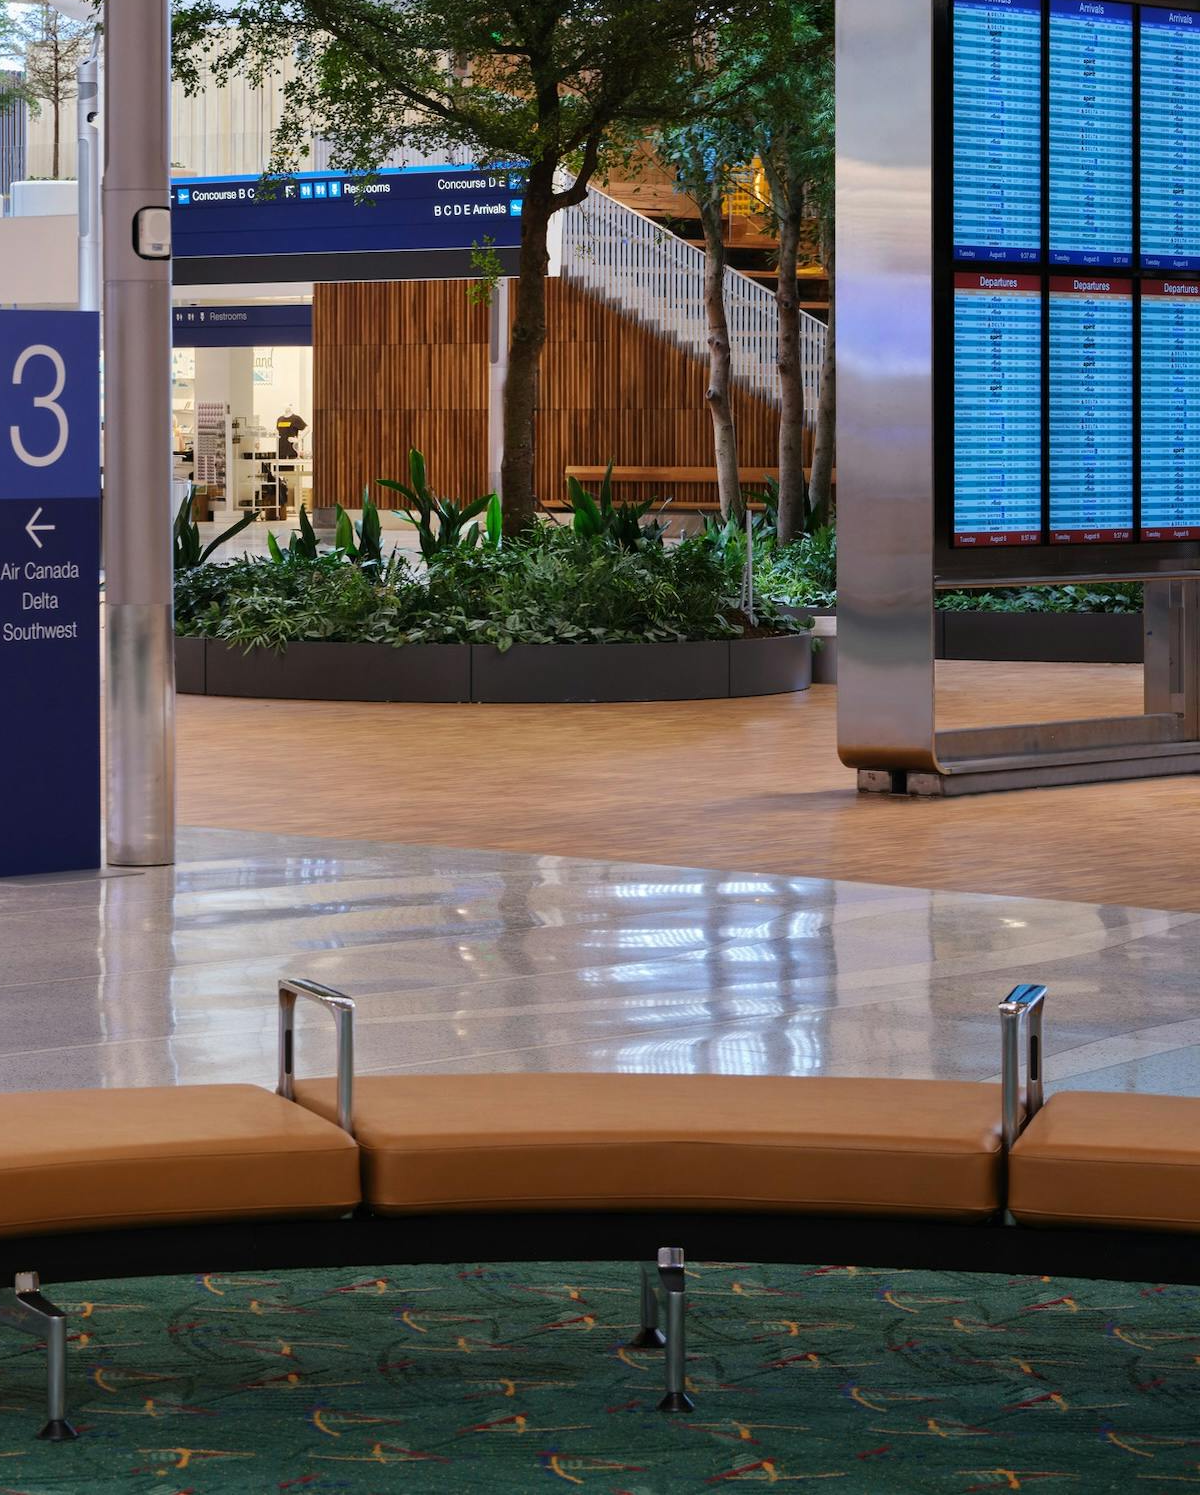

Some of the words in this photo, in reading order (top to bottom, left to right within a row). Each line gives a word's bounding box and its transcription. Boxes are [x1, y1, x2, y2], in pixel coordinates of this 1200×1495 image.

[1080, 2, 1104, 14] Arrivals
[1169, 13, 1192, 24] Arrivals
[343, 183, 391, 194] Resrooms
[437, 178, 487, 190] Concourse
[488, 177, 497, 188] D
[193, 190, 237, 202] Concourse
[238, 189, 246, 200] B
[246, 188, 254, 199] C
[434, 205, 442, 217] B
[443, 204, 452, 216] C
[453, 204, 462, 216] D
[463, 204, 471, 215] E
[472, 203, 507, 215] Arrivals
[959, 249, 976, 258] Tuesday
[989, 249, 1002, 259] August
[1054, 254, 1070, 262] Tuesday
[1083, 256, 1096, 264] August
[1146, 258, 1160, 267] Tuesday
[980, 276, 1018, 288] Departures
[1073, 280, 1110, 291] Departures
[1164, 283, 1199, 294] Departures
[209, 311, 248, 321] Restrooms
[9, 344, 70, 468] 3
[0, 562, 21, 581] Air
[24, 561, 80, 581] Canada
[22, 591, 59, 610] Delta
[2, 621, 78, 642] Southwest
